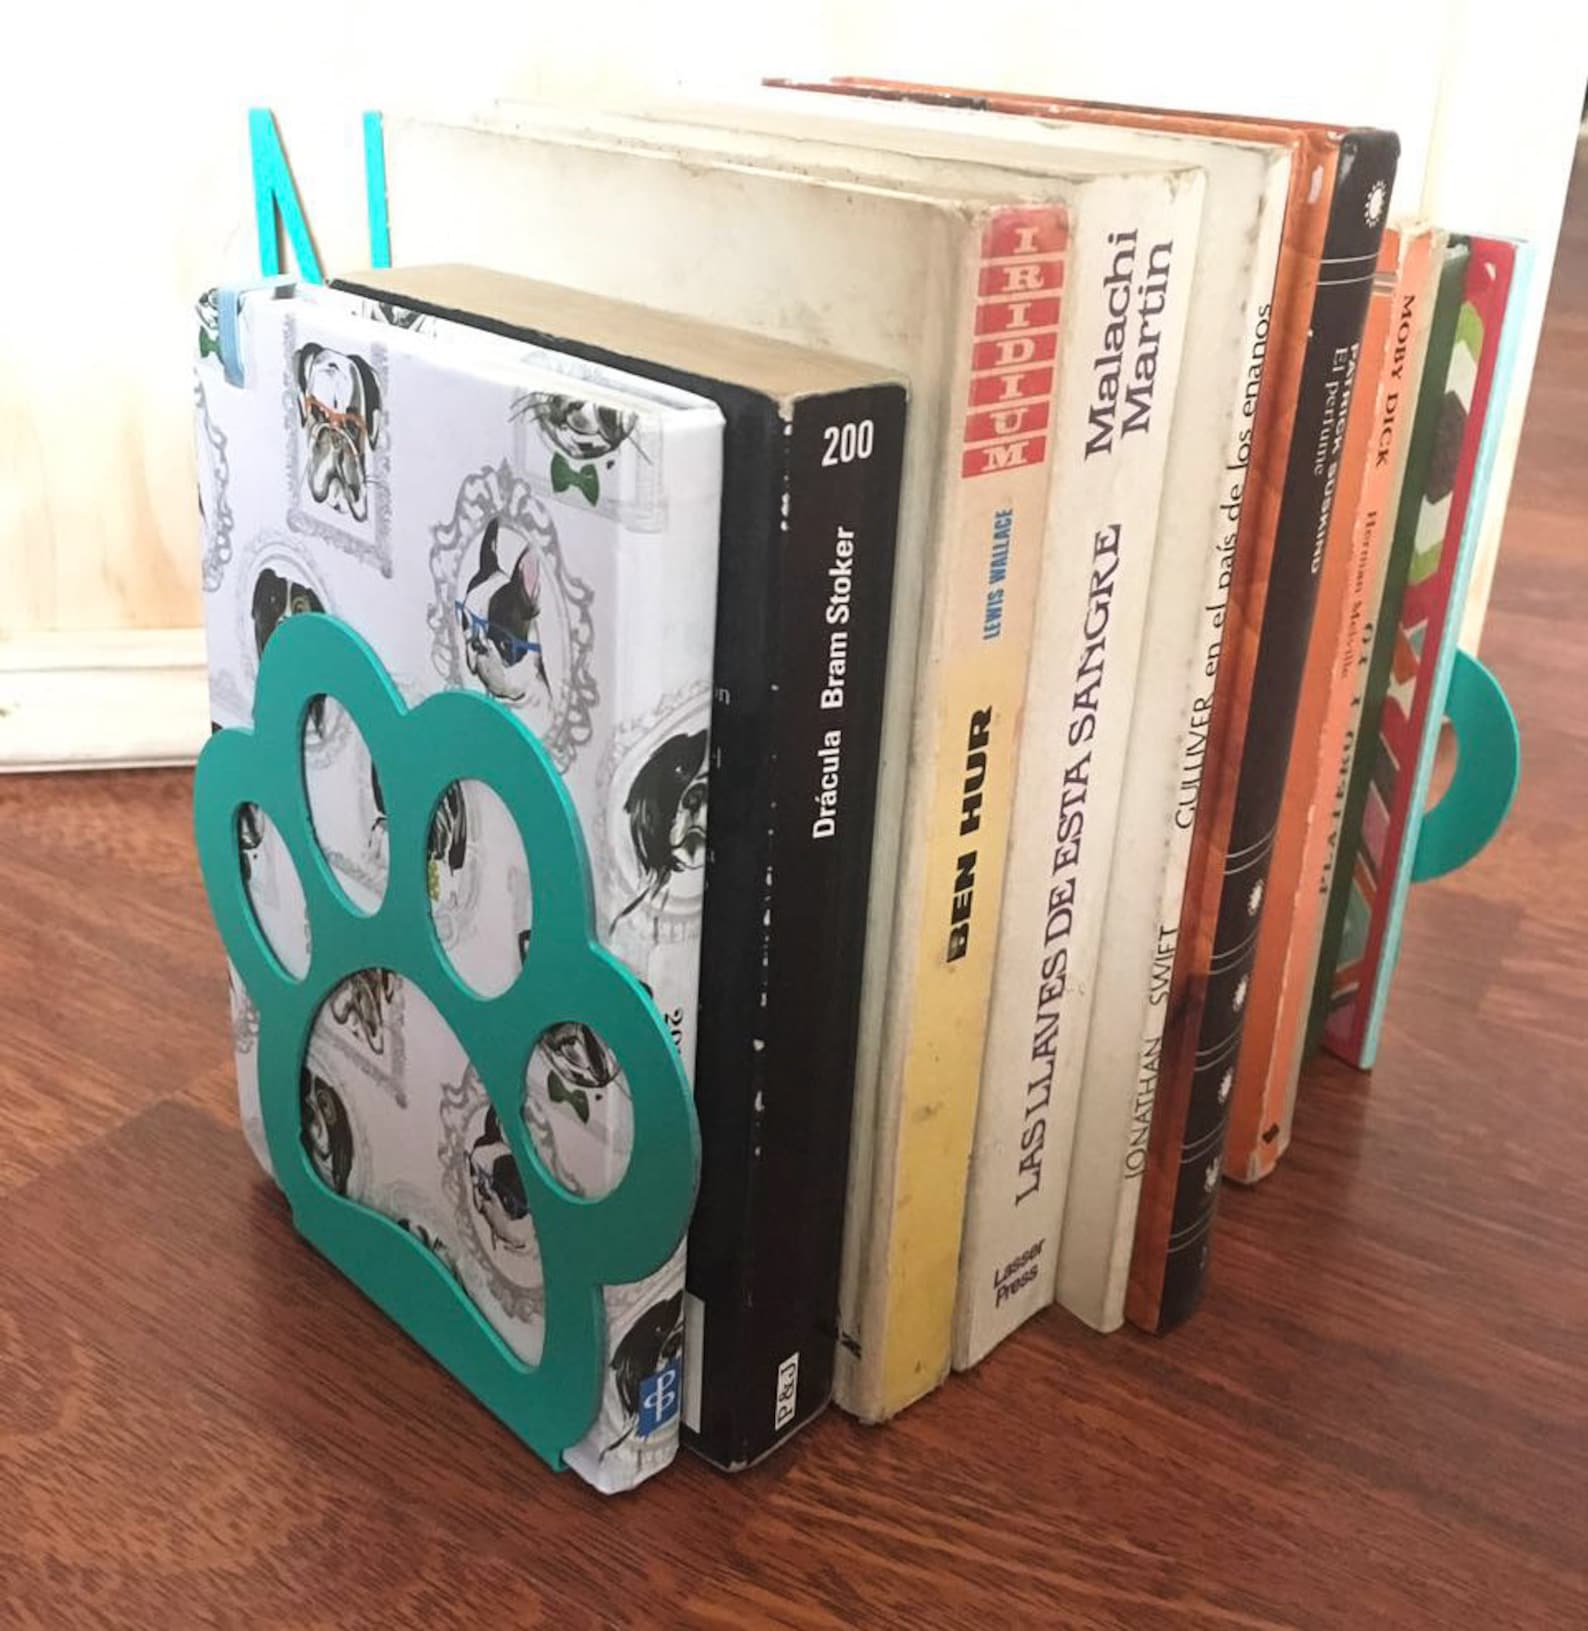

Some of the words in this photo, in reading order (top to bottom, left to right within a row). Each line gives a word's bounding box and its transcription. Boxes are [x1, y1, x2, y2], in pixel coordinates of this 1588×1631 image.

[981, 227, 1045, 472] IRIDIUM
[1084, 228, 1138, 461] Malachi
[1120, 240, 1173, 437] Martin
[1242, 303, 1271, 418] enanos
[1392, 295, 1417, 380] MOBY
[822, 420, 874, 466] 200
[1226, 428, 1252, 470] los
[1375, 393, 1398, 468] DICK
[1220, 484, 1245, 521] de
[826, 526, 855, 624] Stoker
[989, 508, 1013, 584] WALLACE
[1216, 532, 1238, 590] país
[1356, 511, 1378, 593] Herman
[983, 588, 1004, 640] LEWIS
[1068, 523, 1122, 750] SANGRE
[1206, 603, 1227, 629] el
[820, 631, 848, 709] Bram
[1205, 642, 1222, 677] en
[812, 730, 842, 838] Drácula
[960, 705, 993, 836] HUR
[1053, 749, 1092, 877] ESTA
[946, 851, 977, 963] BEN
[1043, 876, 1076, 947] DE
[1027, 947, 1070, 1115] LLAVES
[1125, 1037, 1161, 1180] JONATHAN
[1150, 926, 1178, 1006] SWIFT
[1016, 1117, 1047, 1207] LAS
[994, 1238, 1046, 1290] Lasser
[995, 1264, 1038, 1309] Press
